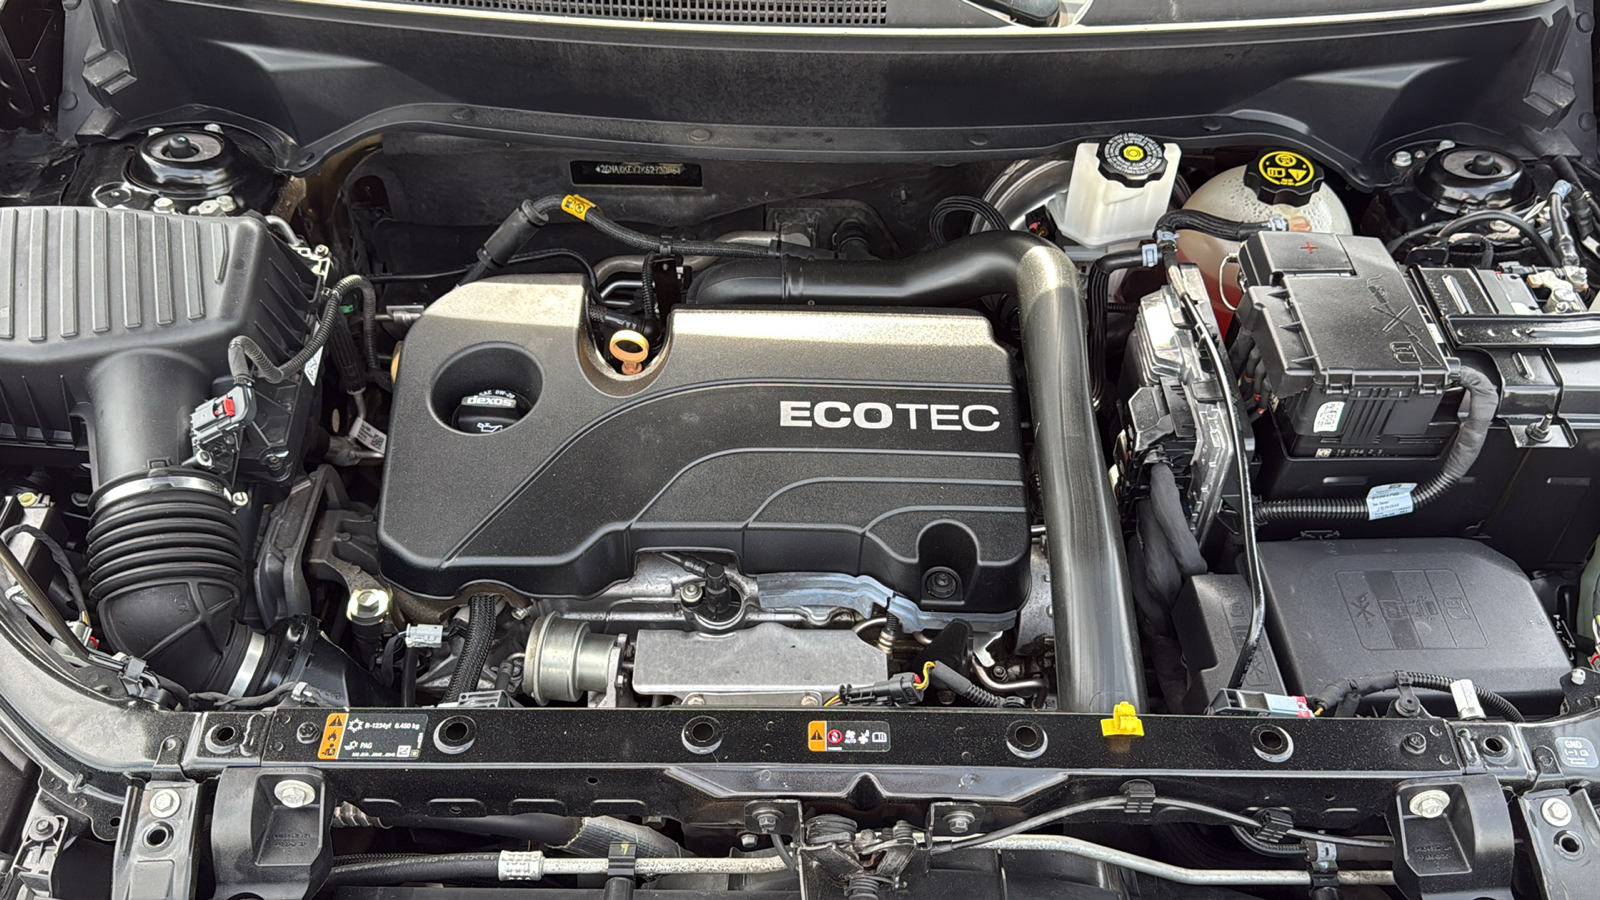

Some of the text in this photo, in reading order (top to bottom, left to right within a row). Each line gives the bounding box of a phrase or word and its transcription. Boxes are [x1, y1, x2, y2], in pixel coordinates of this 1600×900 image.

[467, 396, 512, 406] dexos
[780, 401, 1000, 432] ECOTEC
[364, 722, 392, 730] R-1234yf
[412, 722, 420, 730] kg
[1564, 740, 1582, 749] GND
